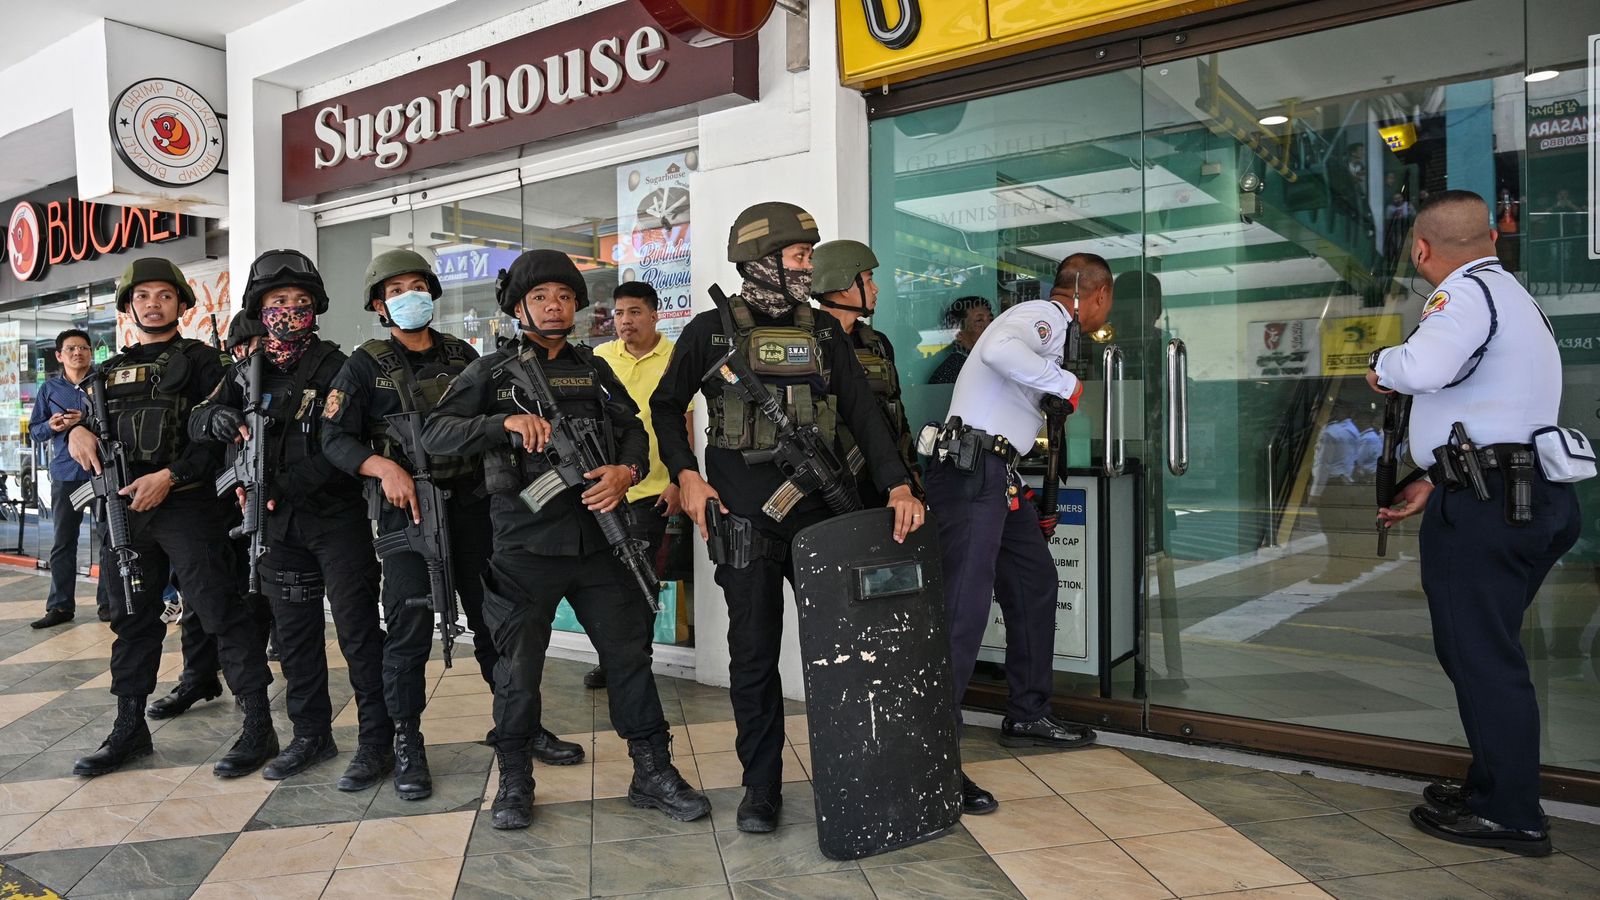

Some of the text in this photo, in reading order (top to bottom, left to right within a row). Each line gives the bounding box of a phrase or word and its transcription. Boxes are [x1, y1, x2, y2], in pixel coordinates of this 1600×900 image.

[122, 81, 218, 129] SHRIMP BUCKET
[315, 26, 665, 170] Sugarhouse
[121, 135, 217, 182] SHRIMP BUCKET
[645, 171, 686, 186] Sugarhouse
[1062, 537, 1079, 546] CAP
[1053, 558, 1079, 567] UBMIT
